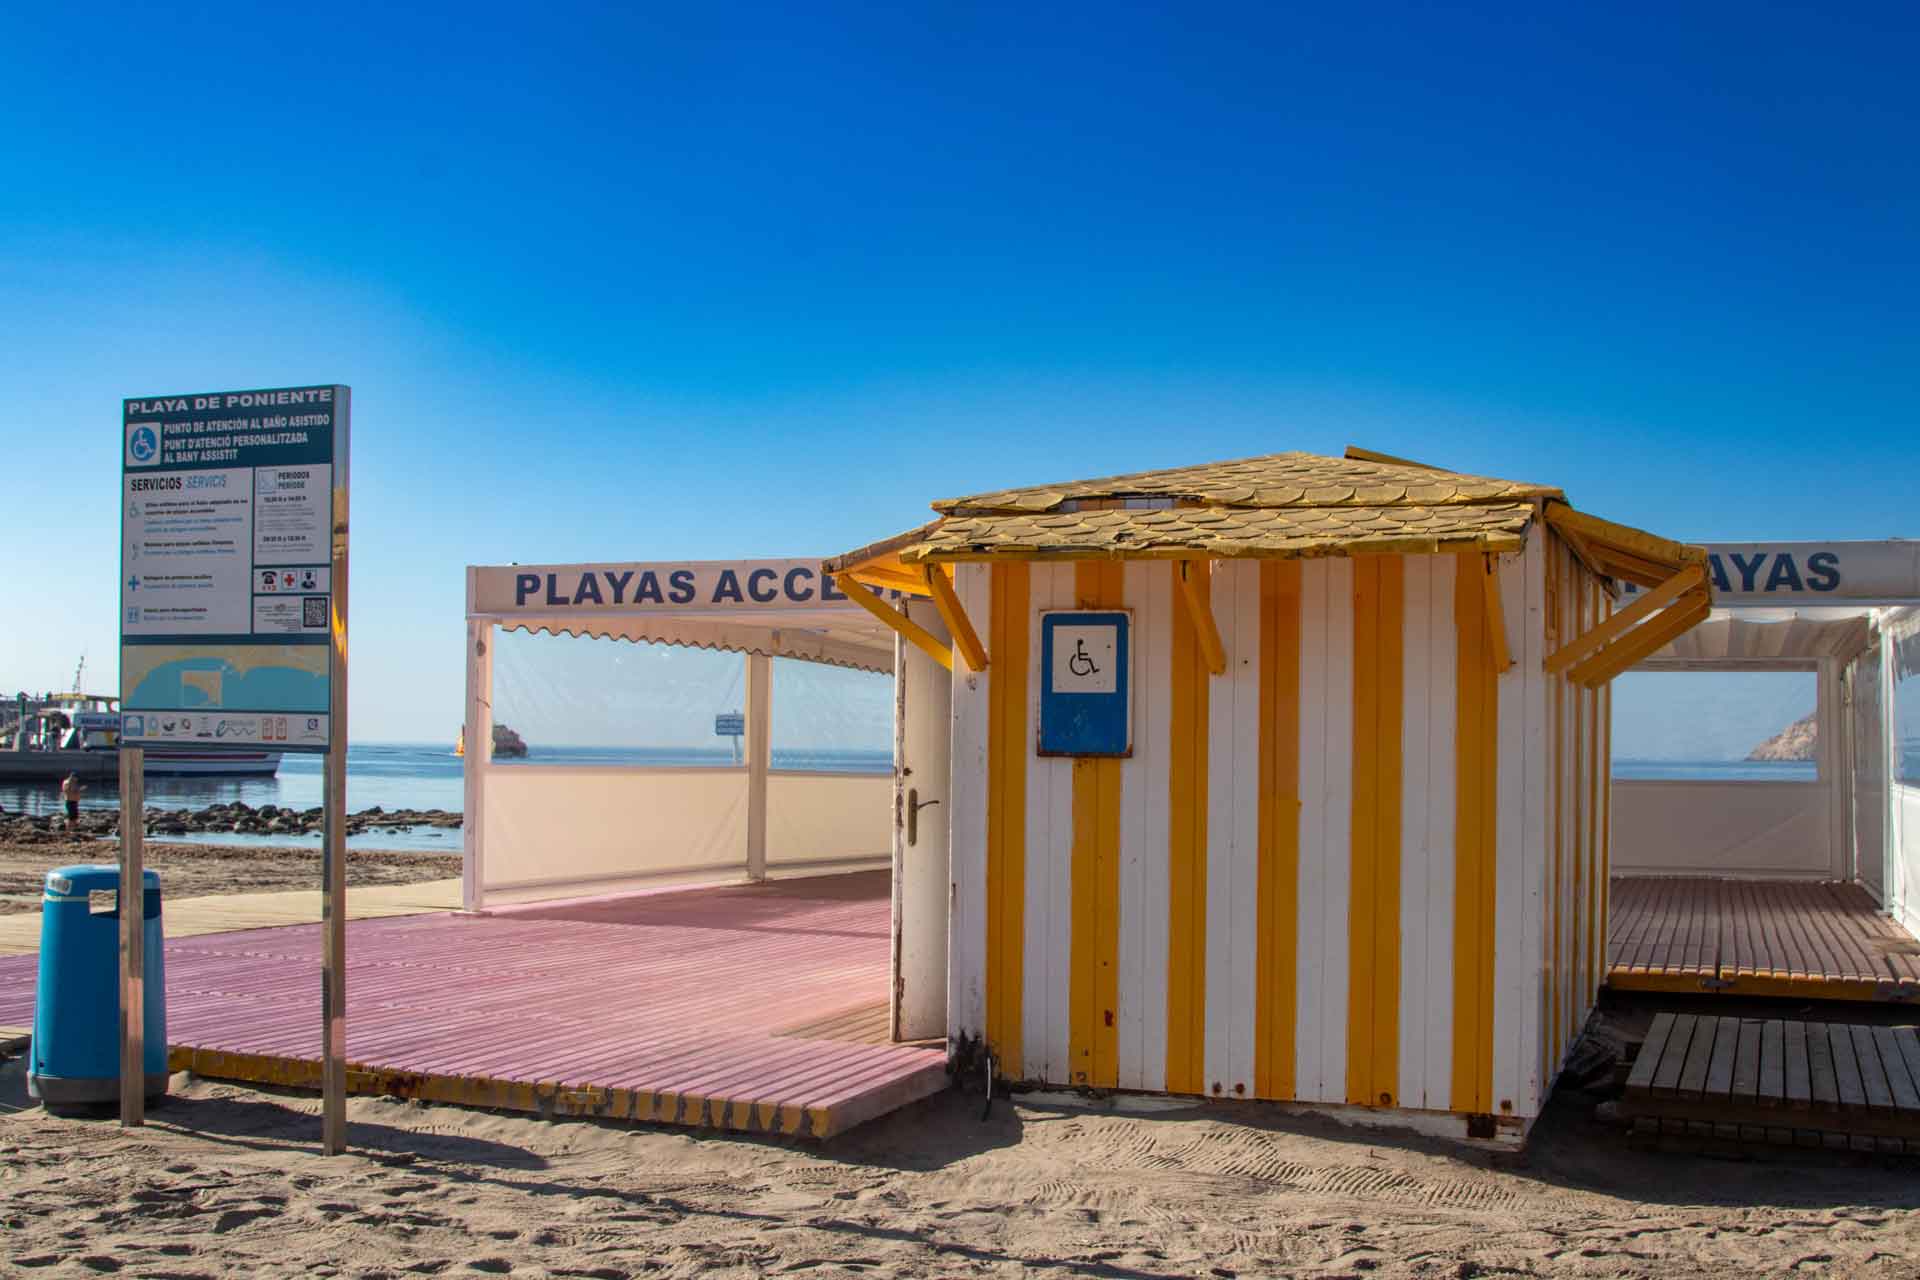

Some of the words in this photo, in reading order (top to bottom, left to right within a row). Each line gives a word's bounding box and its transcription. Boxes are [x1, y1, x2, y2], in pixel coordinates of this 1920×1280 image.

[128, 399, 188, 415] PLAYA
[194, 396, 221, 410] DE
[226, 388, 333, 408] PONIENTE
[163, 422, 192, 434] PUNTO
[193, 421, 205, 433] DE
[206, 418, 249, 433] ATENCIÓN
[250, 417, 262, 429] AL
[263, 415, 287, 428] BAÑO
[288, 414, 330, 427] ASISTIDO
[163, 438, 186, 451] PUNT
[232, 432, 309, 448] PERSONALITZADA
[163, 452, 175, 464] AL
[176, 451, 199, 463] BANY
[200, 449, 238, 462] ASSISTIT
[131, 476, 182, 491] SERVICIOS
[515, 569, 696, 606] PLAYAS
